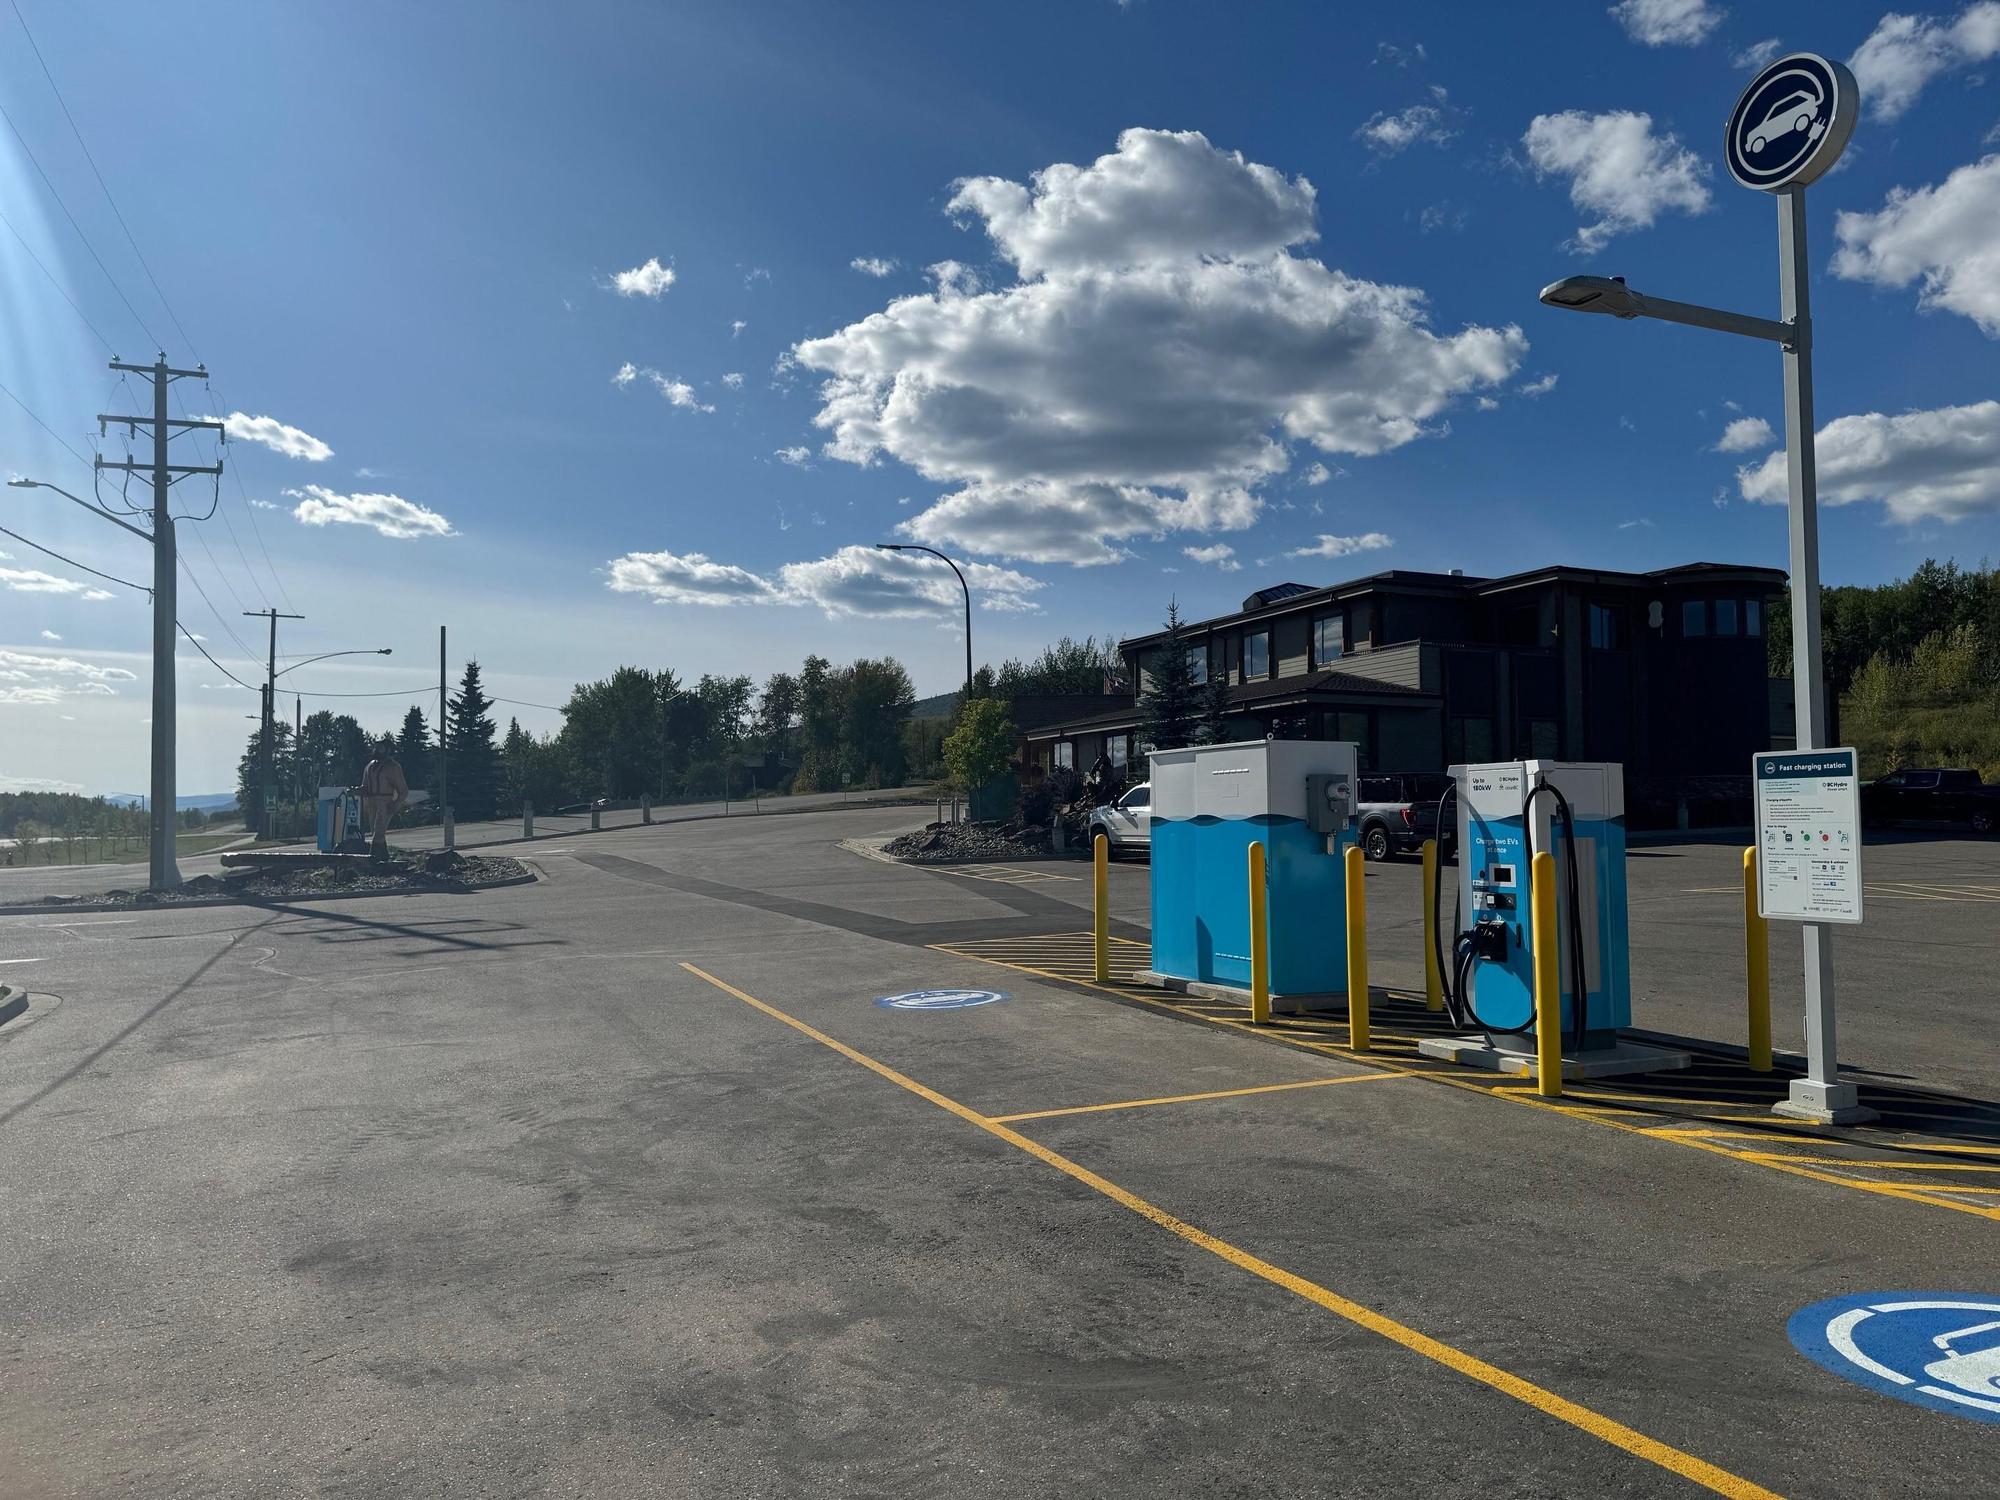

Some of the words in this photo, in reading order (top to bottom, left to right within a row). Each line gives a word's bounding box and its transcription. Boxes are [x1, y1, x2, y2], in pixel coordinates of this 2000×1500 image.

[1794, 763, 1822, 771] charging
[1823, 761, 1847, 769] station
[1475, 837, 1495, 845] Charge
